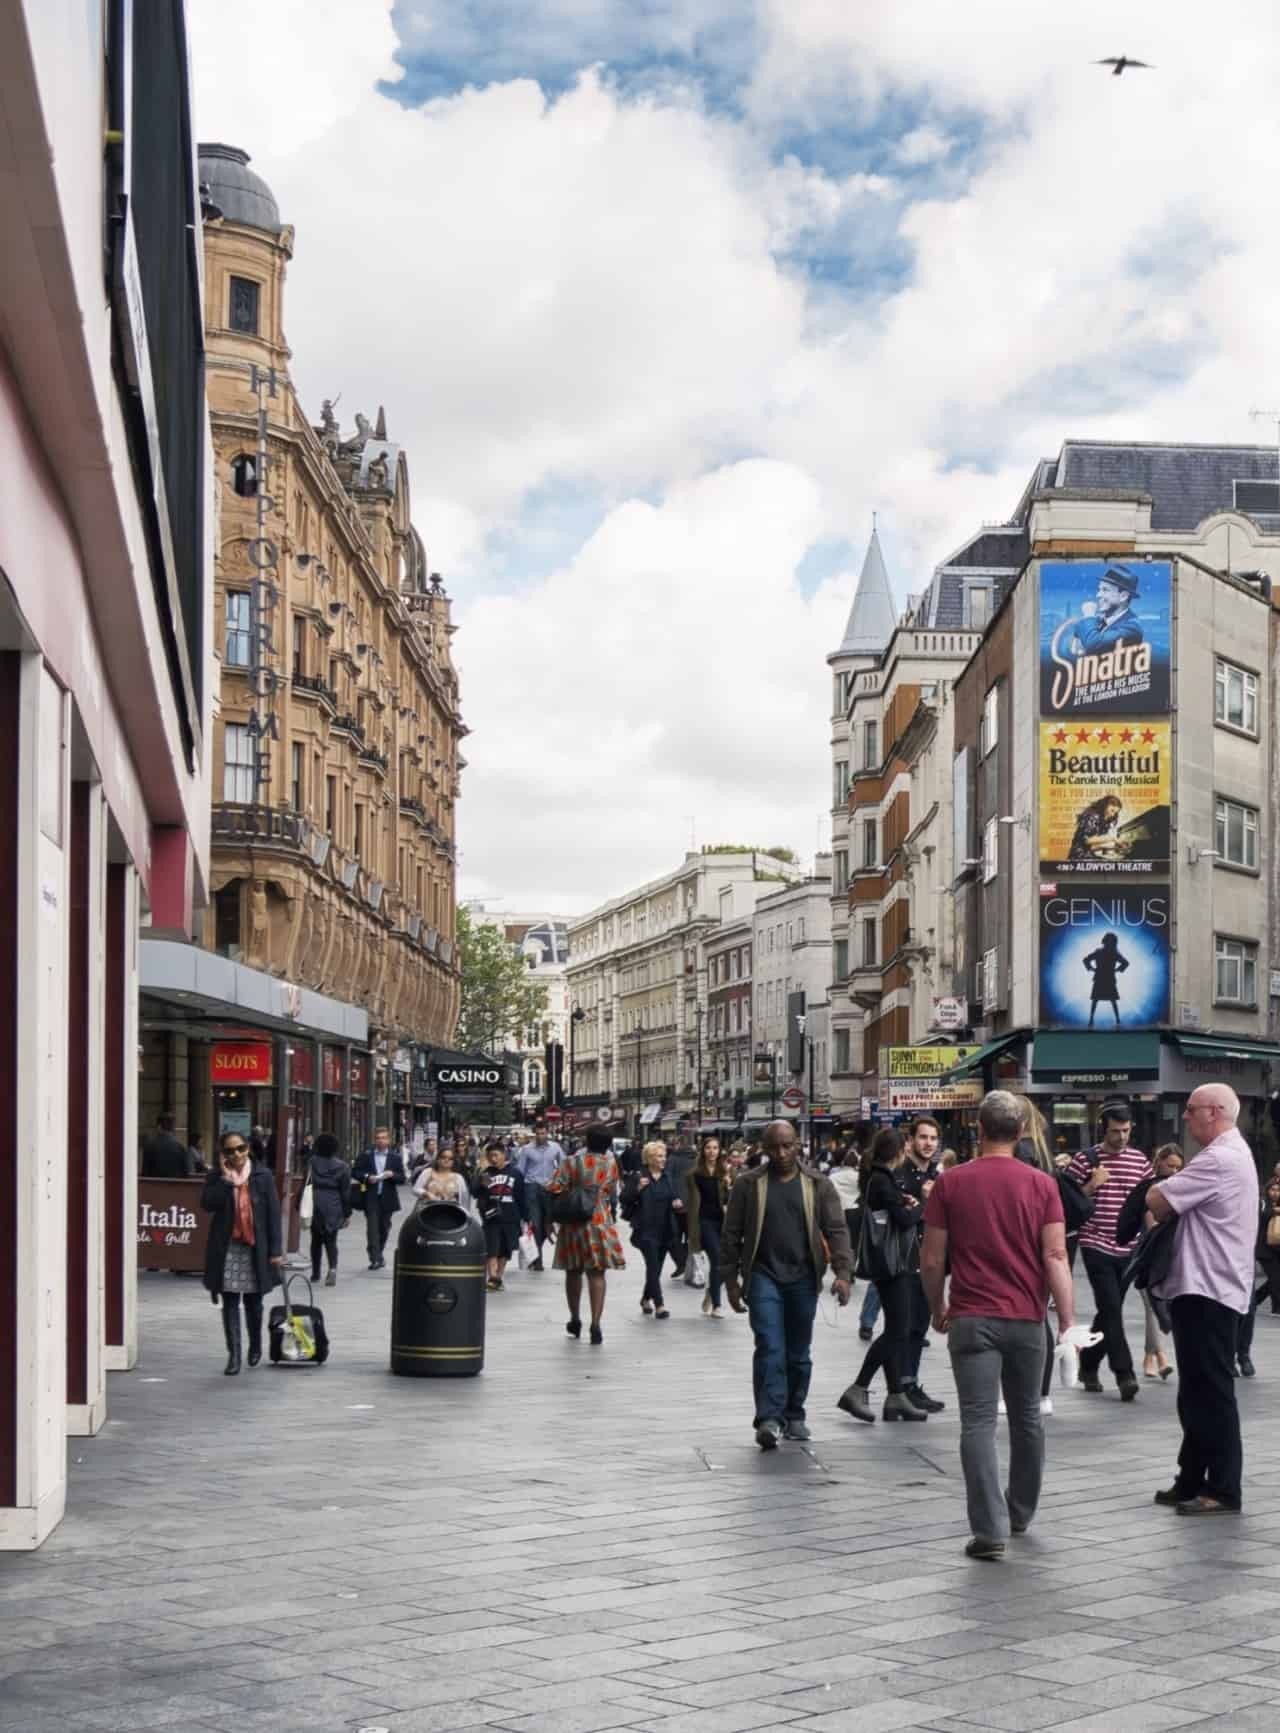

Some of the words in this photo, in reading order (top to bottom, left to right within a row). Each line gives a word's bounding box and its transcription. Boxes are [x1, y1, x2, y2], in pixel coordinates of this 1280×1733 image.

[246, 364, 279, 784] HIPPODROME
[1051, 616, 1152, 710] Sinatra
[1075, 686, 1089, 697] THE
[1090, 682, 1106, 693] MAN
[1114, 677, 1127, 688] HIS
[1128, 672, 1152, 686] MUSIC
[1048, 748, 1160, 774] Beautiful
[1049, 775, 1066, 785] The
[1068, 775, 1098, 785] Carole
[1099, 775, 1122, 787] King
[1123, 775, 1160, 785] Musical
[1117, 862, 1153, 872] THEATRE
[1044, 898, 1168, 927] GENIUS
[215, 1054, 259, 1070] SLOTS
[891, 1050, 916, 1062] SUNNY
[438, 1070, 500, 1083] CASINO
[1061, 1073, 1105, 1083] ESPRESSO
[139, 1203, 198, 1229] Italia
